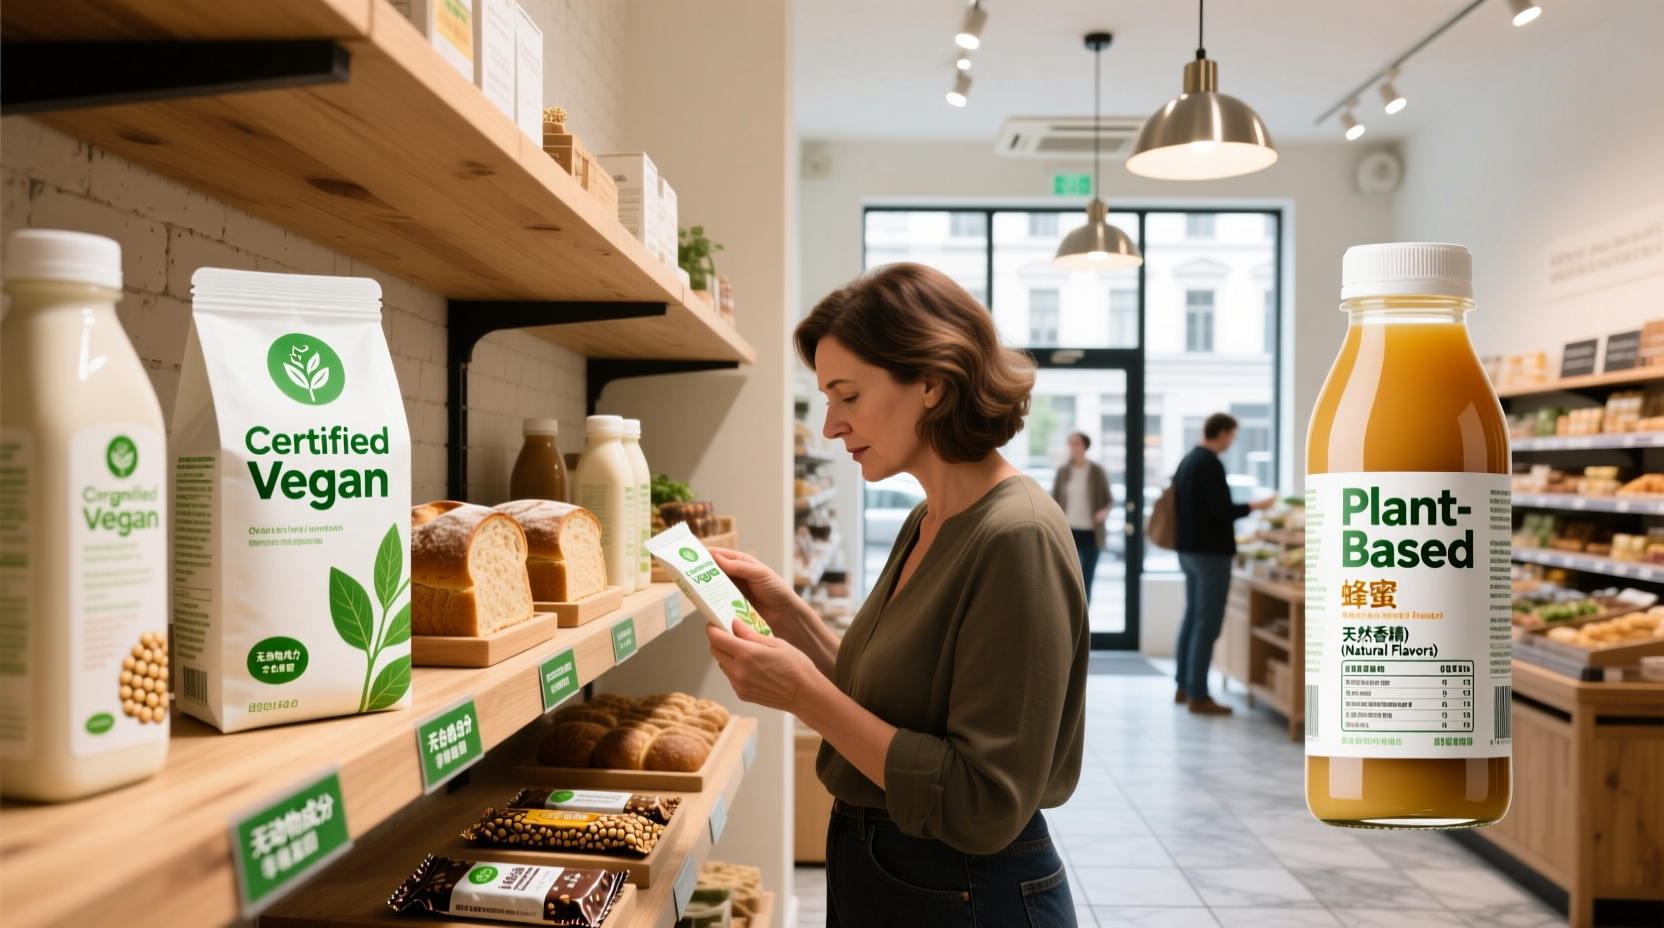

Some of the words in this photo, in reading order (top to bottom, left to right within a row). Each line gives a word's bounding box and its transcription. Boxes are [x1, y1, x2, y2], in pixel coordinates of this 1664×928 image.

[245, 425, 389, 455] Certified
[247, 461, 388, 511] Vegan
[83, 507, 159, 537] Vegan
[1342, 486, 1472, 526] Plant-
[1342, 529, 1474, 569] Based
[1341, 578, 1398, 610] 蜂蜜
